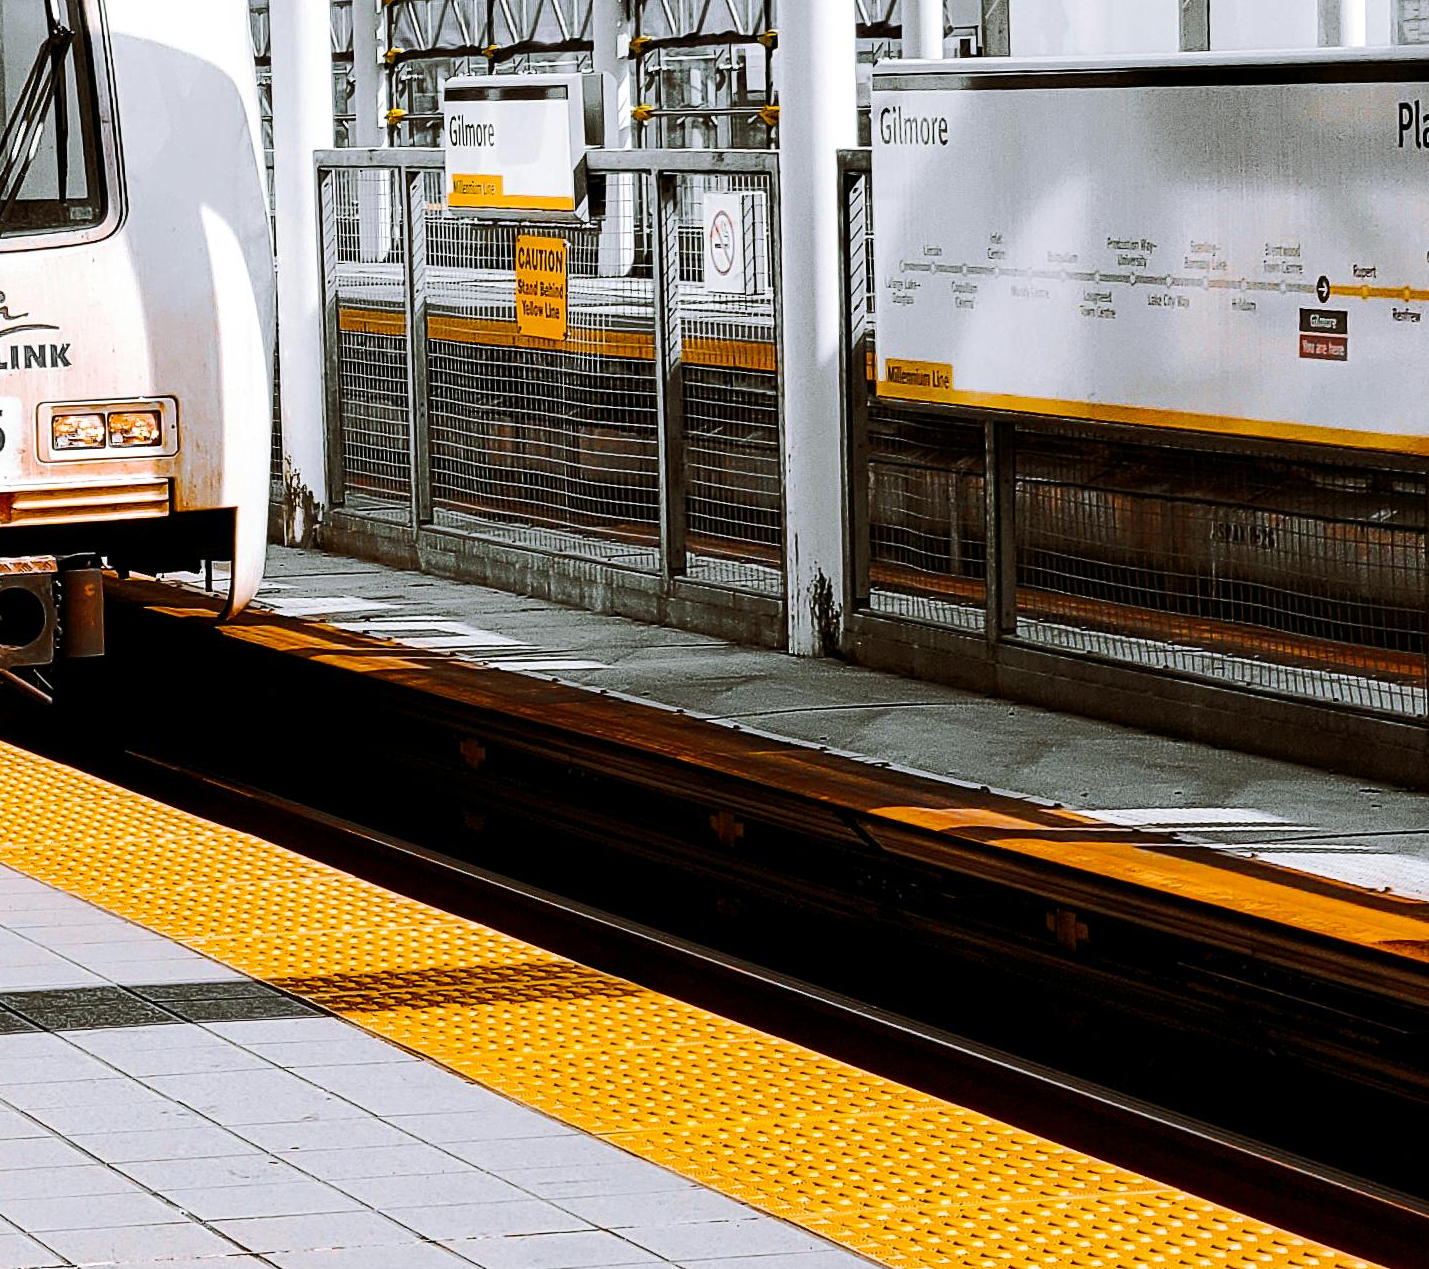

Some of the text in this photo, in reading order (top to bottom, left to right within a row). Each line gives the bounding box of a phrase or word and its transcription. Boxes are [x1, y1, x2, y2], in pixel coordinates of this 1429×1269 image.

[449, 114, 494, 147] Gilmore
[880, 105, 948, 146] Gilmore
[518, 246, 563, 273] CAUTION
[518, 279, 563, 299] Stand Behind
[522, 300, 560, 319] Yellow Line
